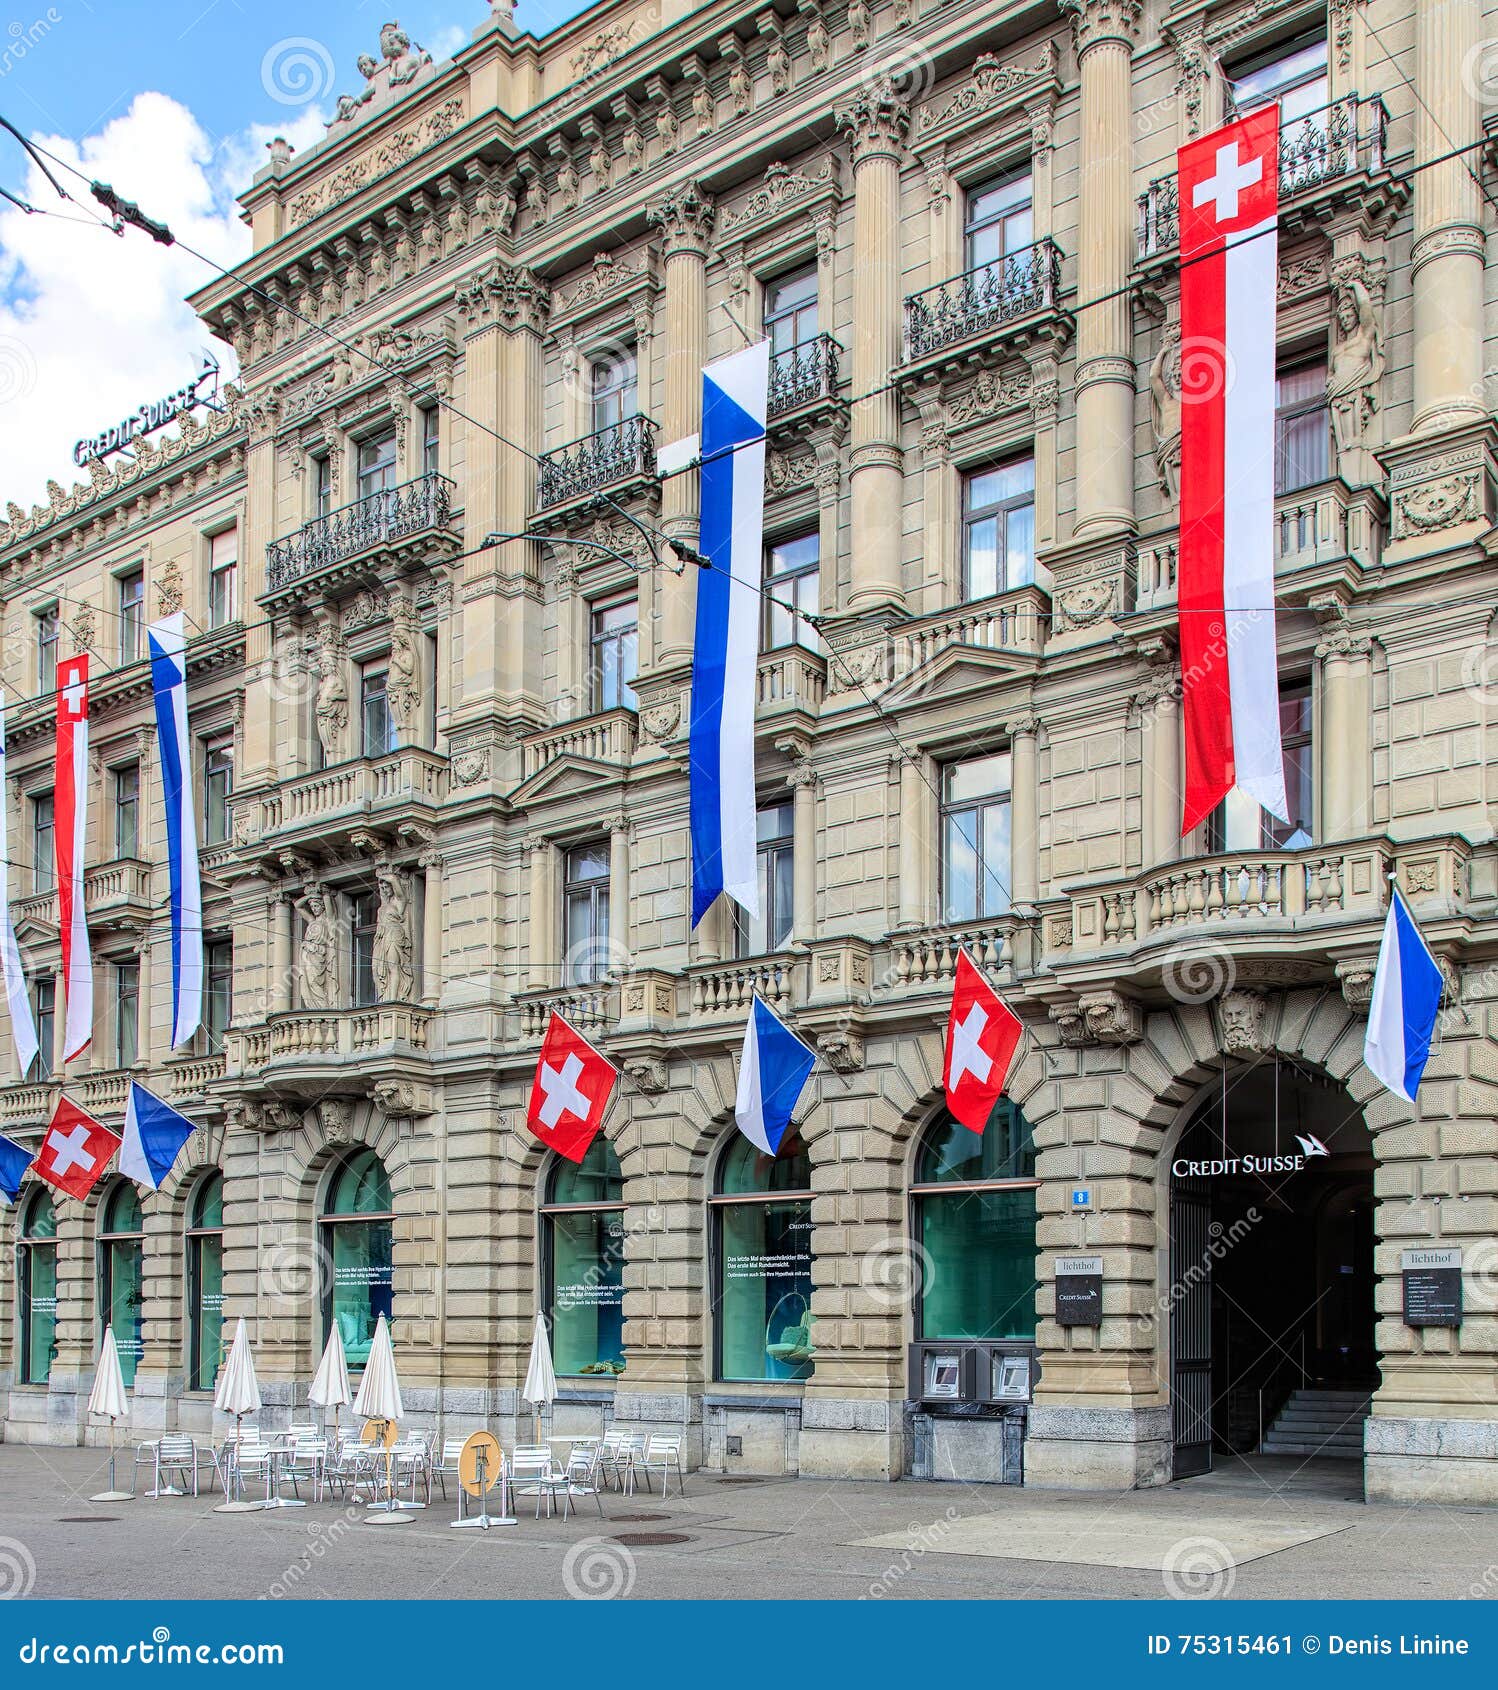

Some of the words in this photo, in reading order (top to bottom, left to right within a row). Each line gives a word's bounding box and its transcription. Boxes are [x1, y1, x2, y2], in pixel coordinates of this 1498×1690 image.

[1172, 1159, 1241, 1177] CREDIT
[1242, 1154, 1304, 1174] SUISSE
[1078, 1193, 1084, 1203] 8
[1411, 1252, 1452, 1263] lichthof
[1063, 1261, 1095, 1271] lichthof
